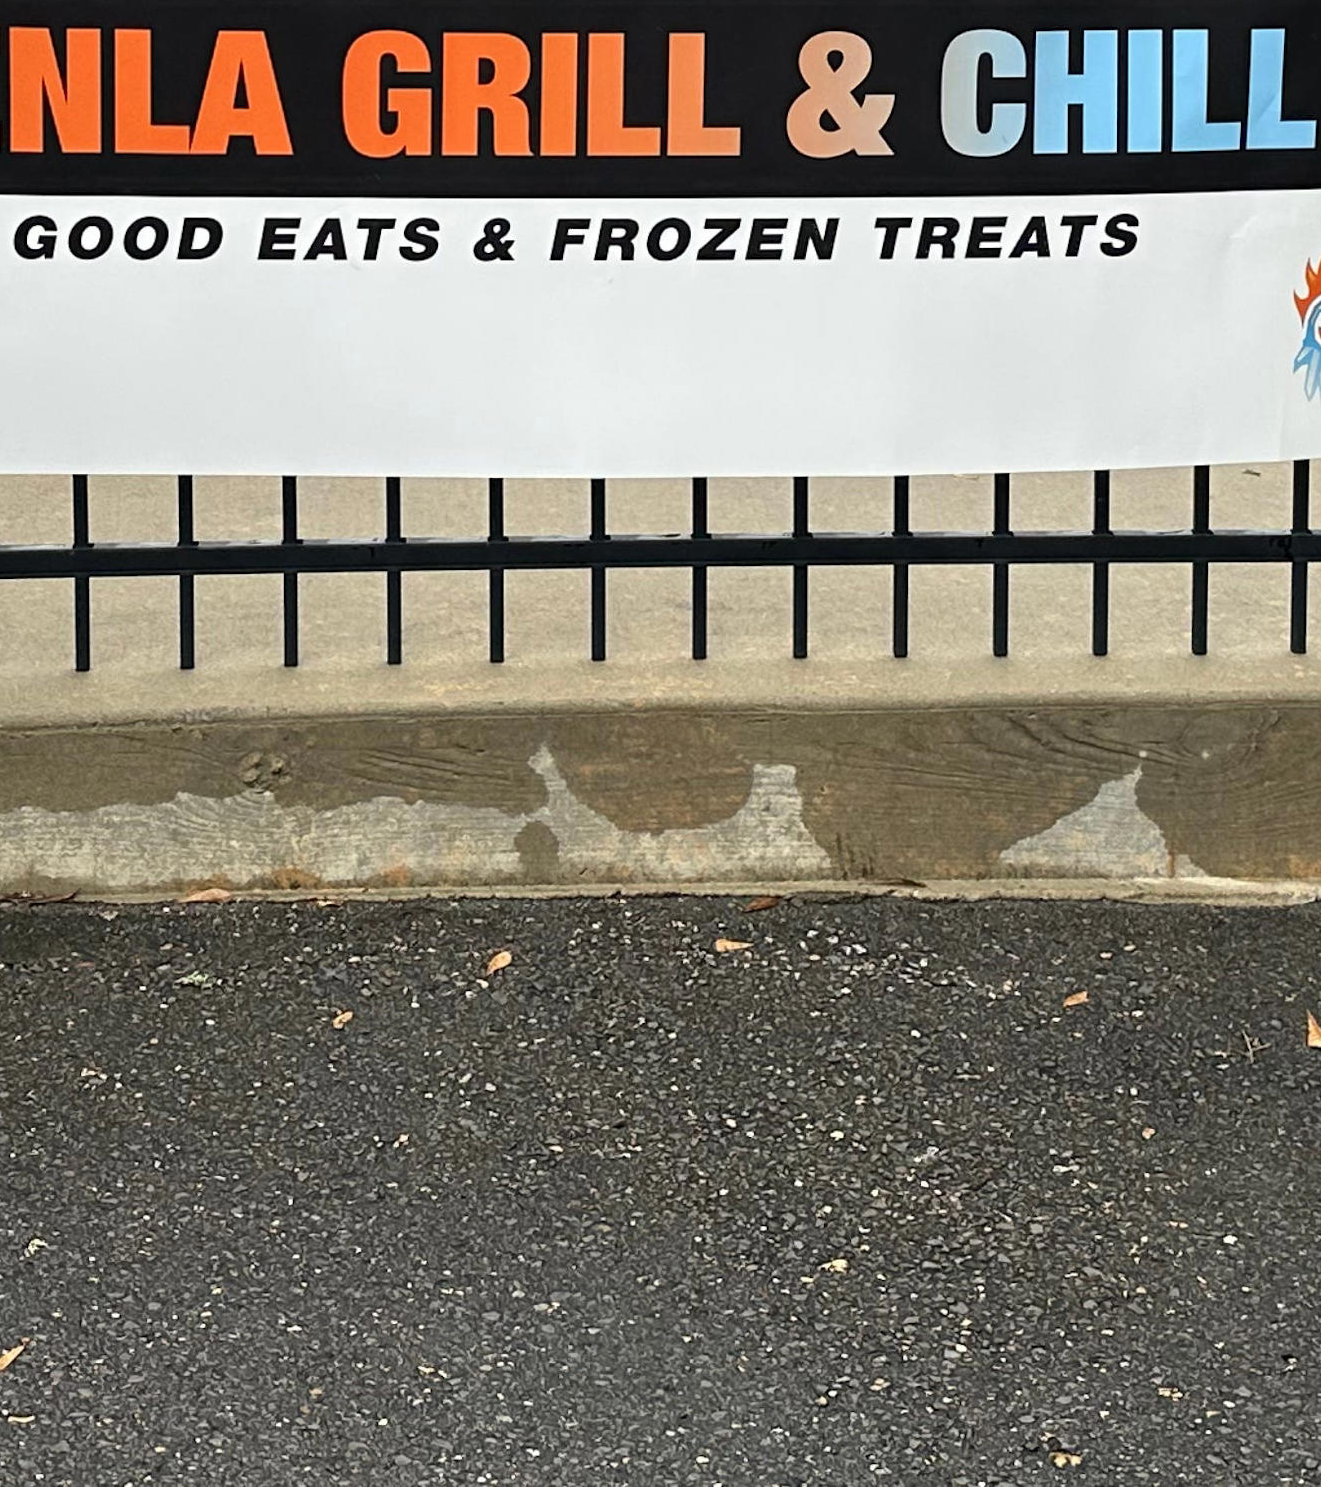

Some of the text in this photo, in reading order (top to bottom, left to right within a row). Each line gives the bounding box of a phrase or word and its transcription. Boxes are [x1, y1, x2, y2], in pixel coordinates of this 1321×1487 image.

[342, 30, 740, 158] GRILL
[787, 31, 895, 158] &
[941, 29, 1316, 158] CHILL
[14, 214, 1138, 261] GOOD EATS & FROZEN TREATS
